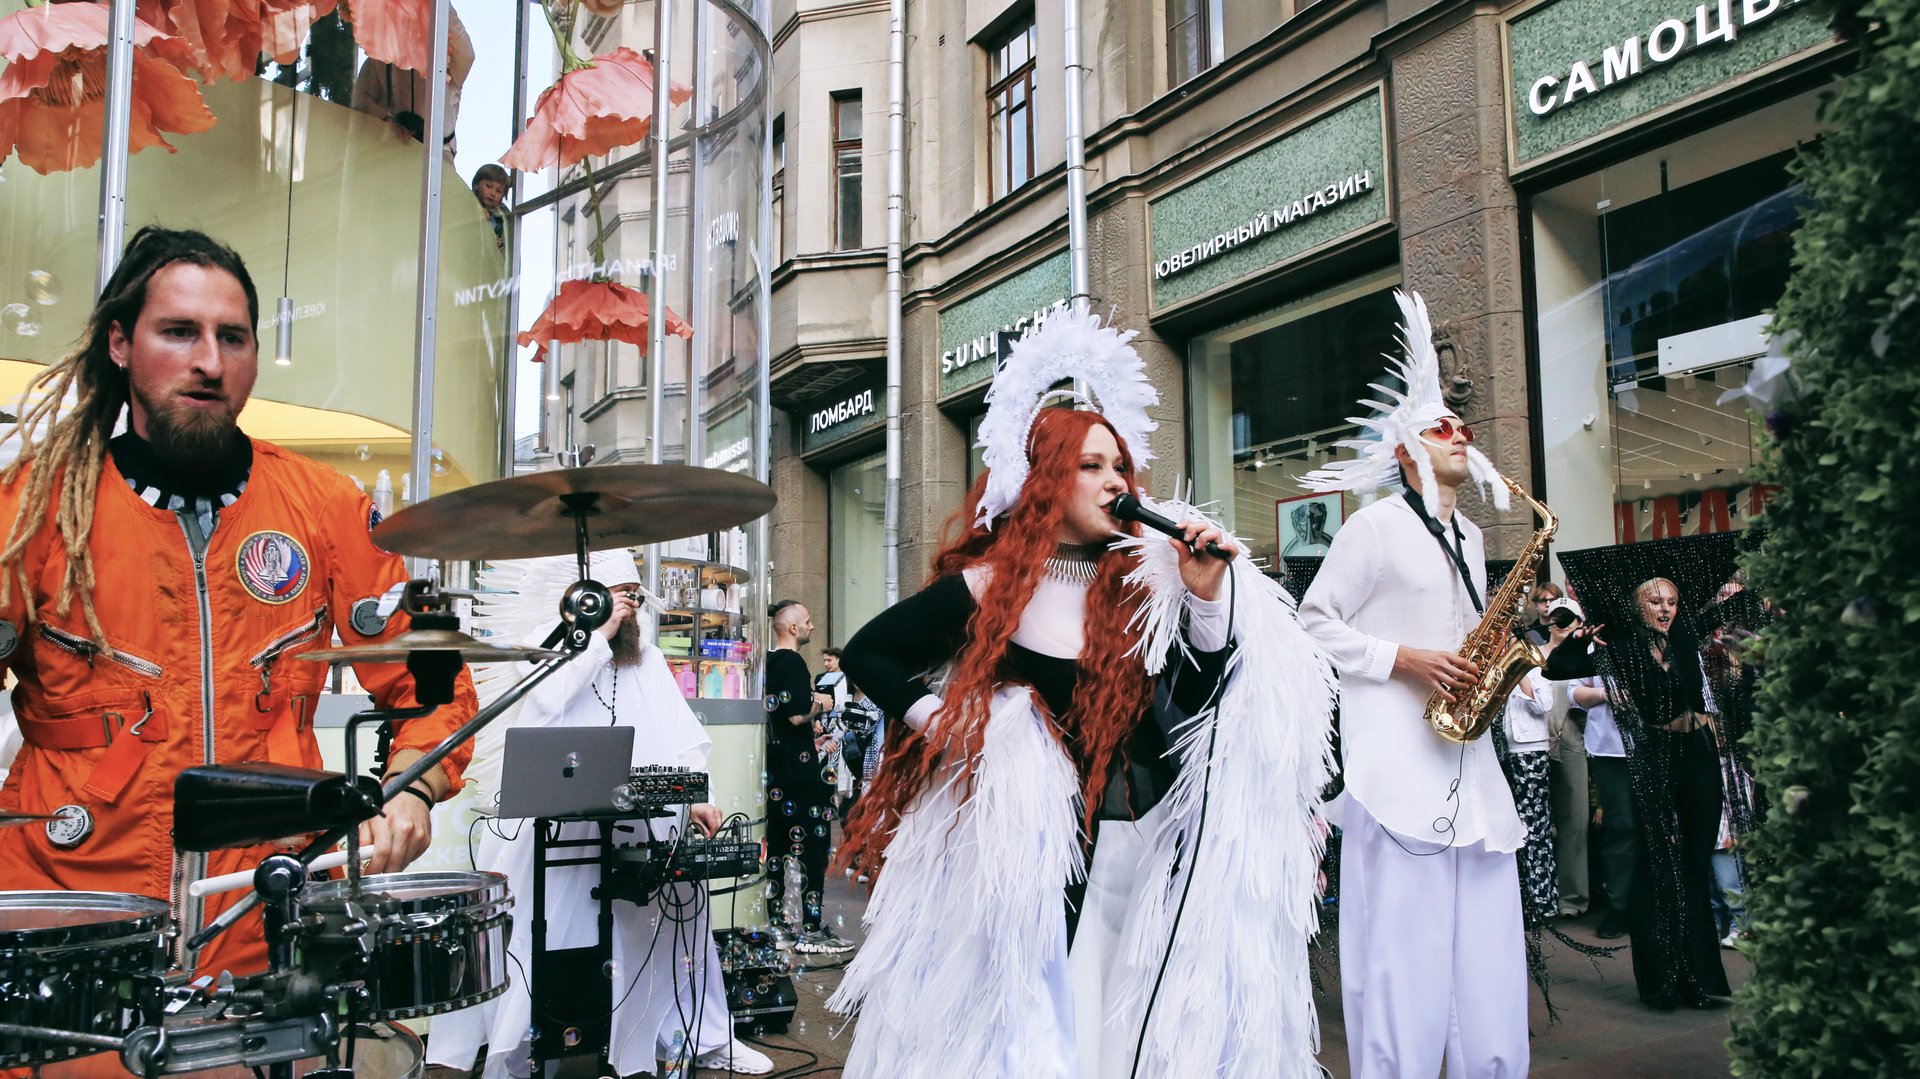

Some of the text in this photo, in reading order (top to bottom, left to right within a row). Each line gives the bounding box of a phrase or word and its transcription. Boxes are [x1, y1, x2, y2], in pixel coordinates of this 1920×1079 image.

[1528, 0, 1800, 115] САМОЦВ
[1155, 170, 1372, 279] ЮВЕЛИРНЫЙ МАГАЗИН
[942, 298, 1065, 374] SUNLGH
[811, 389, 873, 433] ЛОМБАРД
